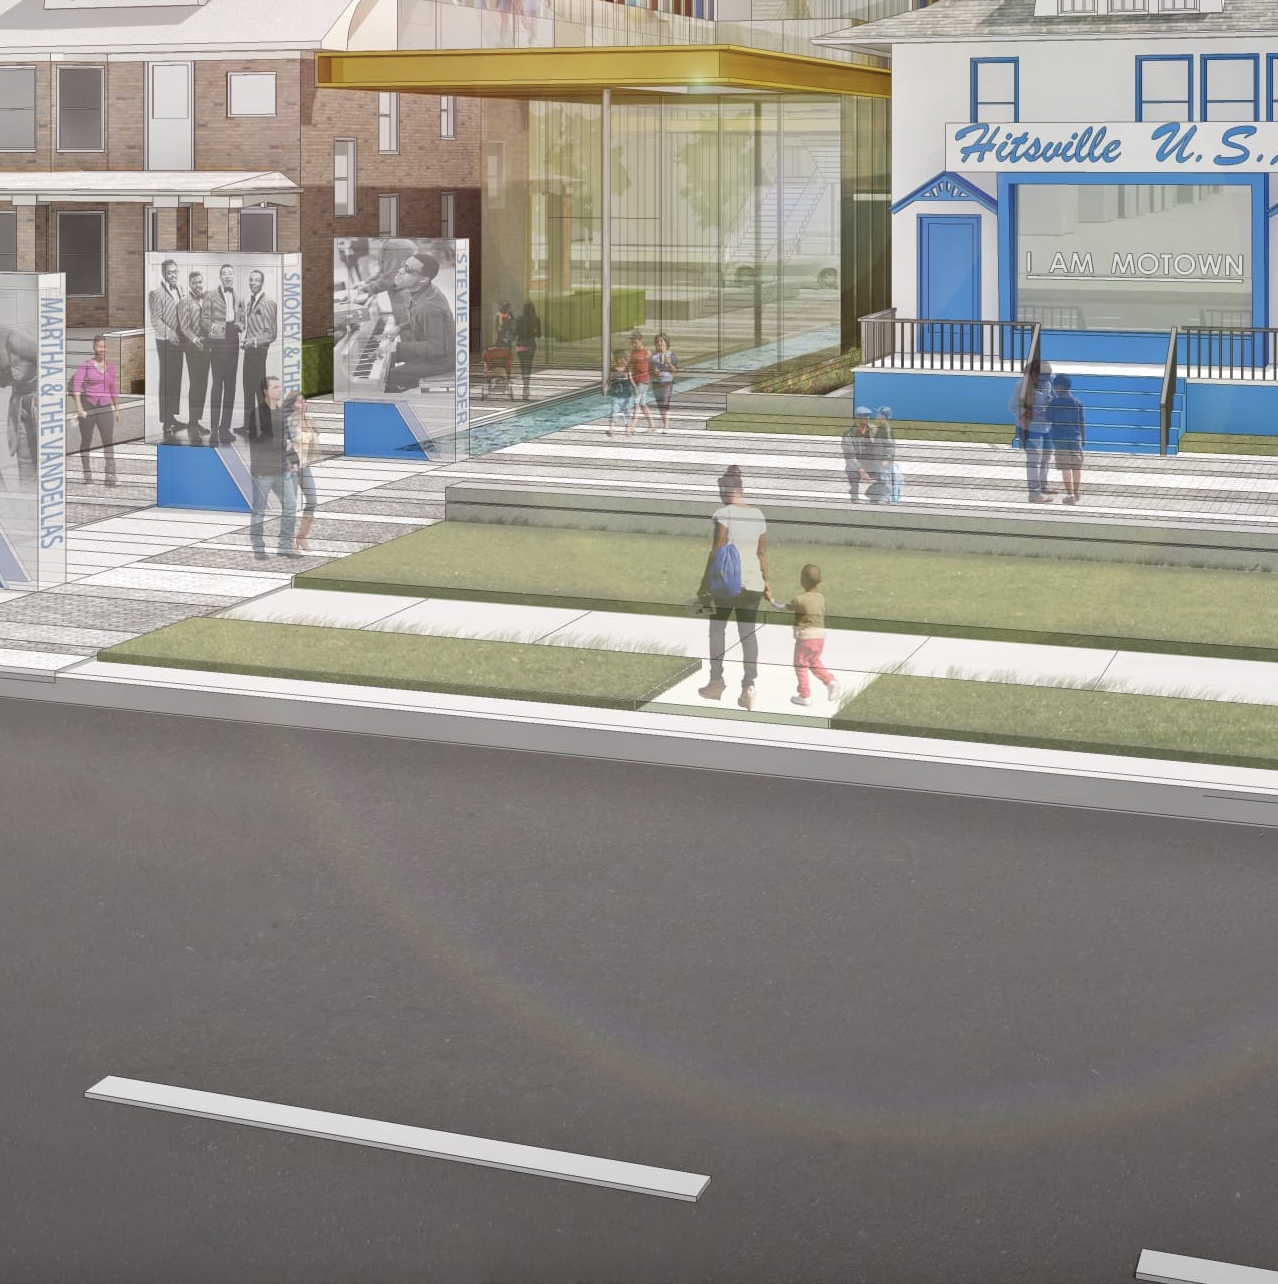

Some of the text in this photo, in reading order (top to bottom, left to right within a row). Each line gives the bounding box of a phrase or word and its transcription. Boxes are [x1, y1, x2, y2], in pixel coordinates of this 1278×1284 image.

[954, 123, 1122, 164] Hitsville
[1025, 250, 1244, 277] I AM MOTOWN
[284, 272, 300, 394] SMOKEY & THE
[456, 253, 468, 425] STEVIE WONDER
[40, 297, 64, 549] MARTHA & THE VANDELLAS
